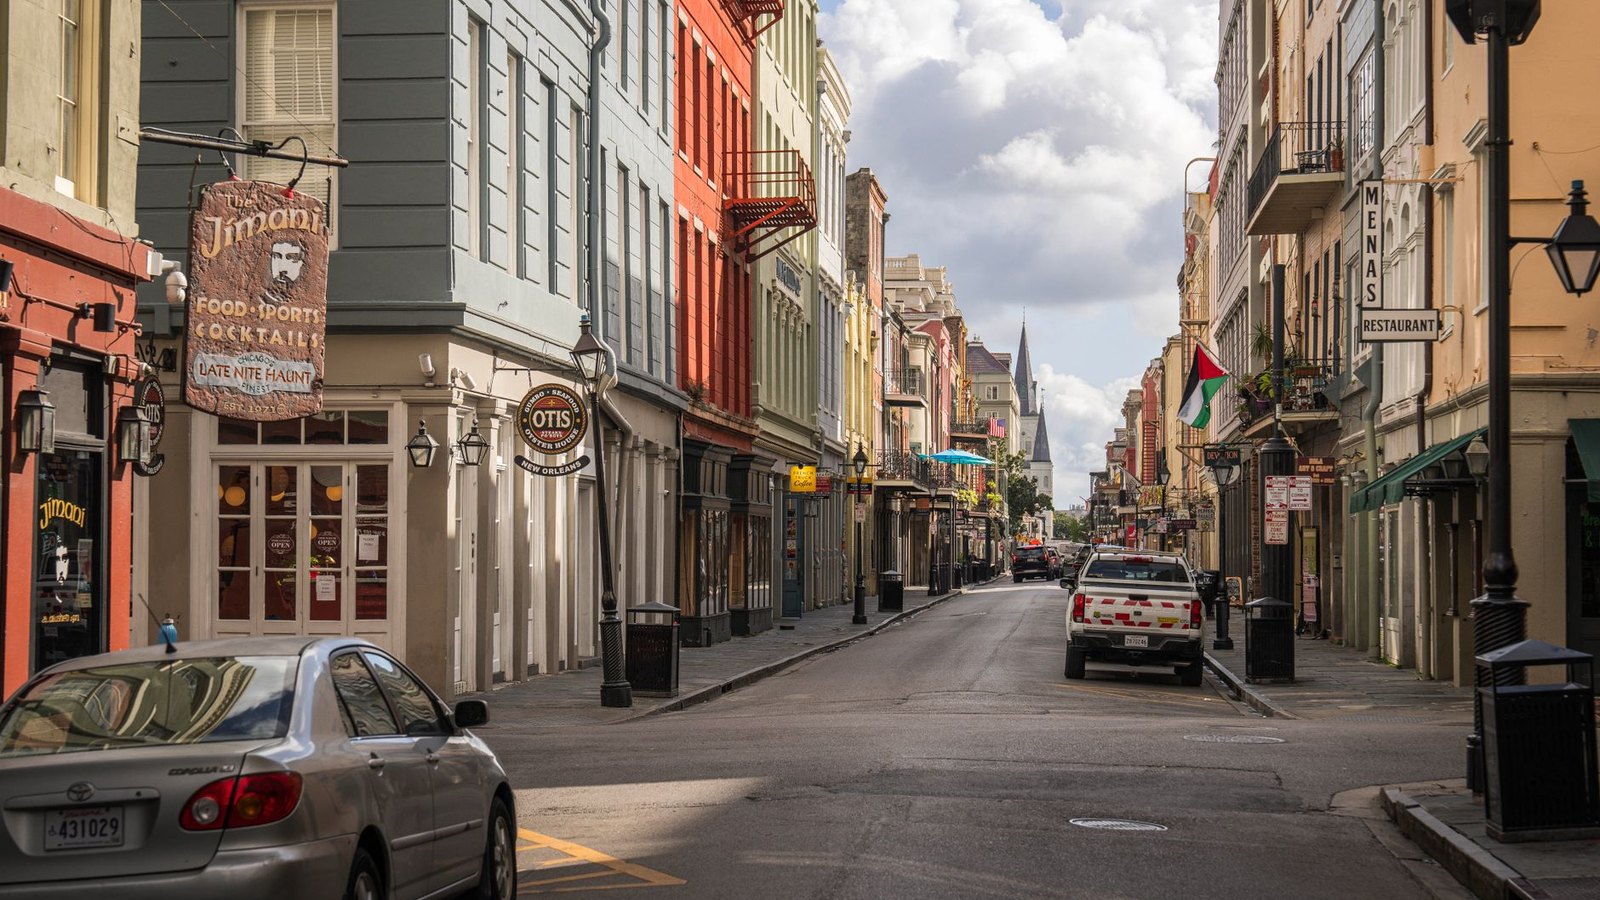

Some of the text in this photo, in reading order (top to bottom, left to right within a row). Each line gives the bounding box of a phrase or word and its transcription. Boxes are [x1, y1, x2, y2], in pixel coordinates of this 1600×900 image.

[225, 194, 253, 208] The
[201, 206, 322, 259] Jimani
[1365, 186, 1379, 303] MENAS
[196, 297, 320, 324] FOOD SPORTS
[195, 322, 319, 348] COCKTAILS
[1363, 319, 1435, 332] RESTAURANT
[200, 363, 311, 384] LATE NITE HAUNT
[241, 382, 270, 394] FINEST
[524, 389, 580, 413] GUMBO SEAFOOD
[144, 403, 160, 423] OTIS
[532, 410, 571, 428] OTIS
[525, 428, 579, 449] OYSTER HOUSE
[521, 460, 582, 475] NEW ORLEANS
[793, 480, 813, 488] Coffee
[40, 497, 86, 529] Jimani
[58, 817, 119, 840] 431029
